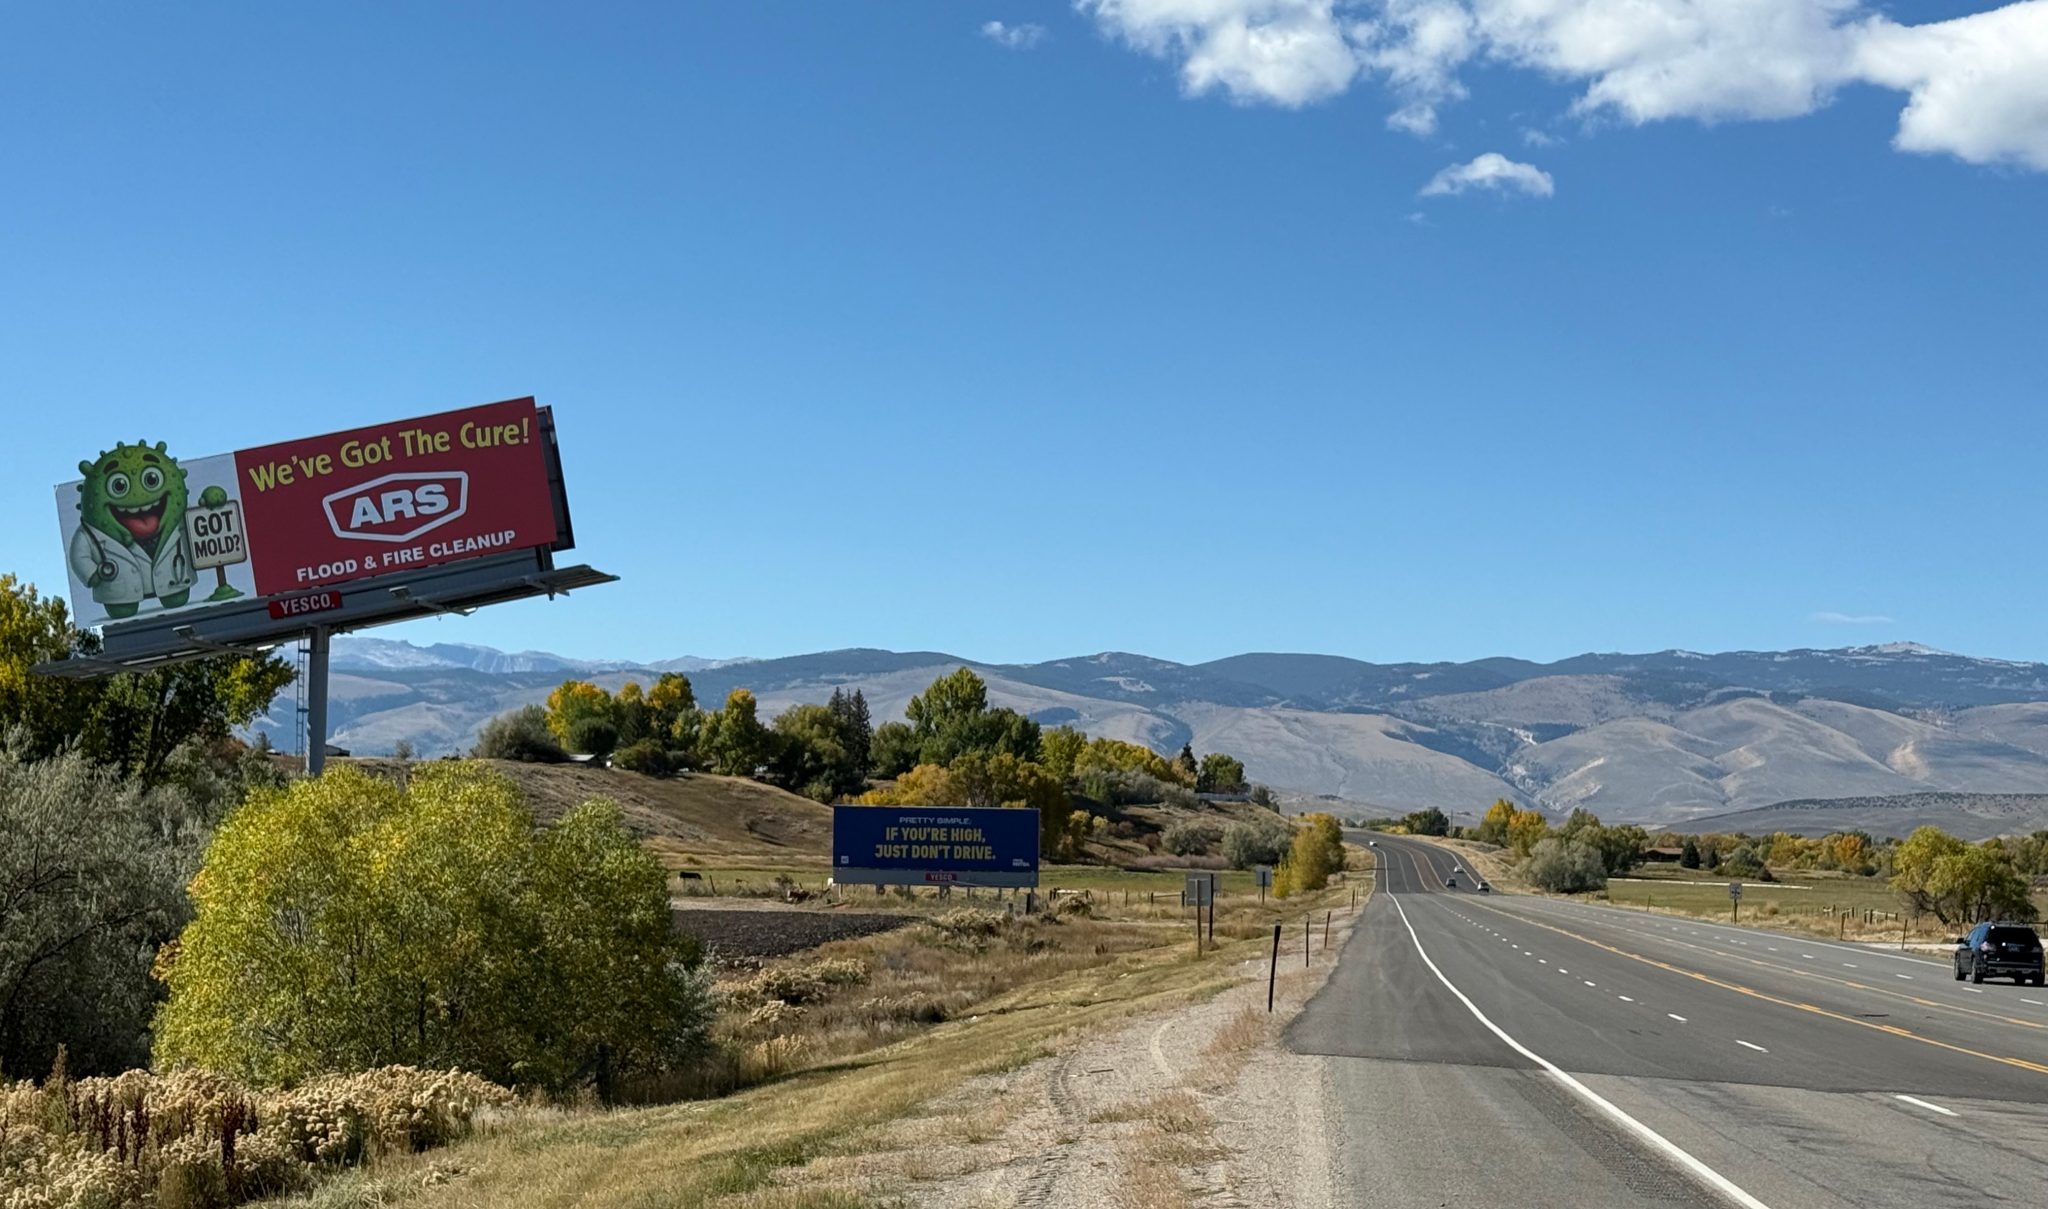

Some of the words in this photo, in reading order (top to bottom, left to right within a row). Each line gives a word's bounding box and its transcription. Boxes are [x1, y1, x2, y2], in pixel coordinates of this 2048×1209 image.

[248, 455, 333, 492] We've
[340, 436, 393, 468] Got
[398, 428, 451, 457] The
[460, 417, 529, 449] Cure!
[349, 483, 449, 529] ARS
[194, 510, 233, 537] GOT
[194, 534, 240, 559] MOLD?
[296, 559, 358, 583] FLOOD
[364, 555, 378, 570] &
[382, 546, 425, 567] FIRE
[429, 530, 516, 558] CLEANUP
[899, 816, 935, 825] PRETTY
[885, 827, 899, 841] IF
[901, 827, 948, 841] YOU'RE
[950, 828, 987, 843] HIGH,
[874, 844, 909, 858] JUST
[911, 845, 950, 859] DON'T
[953, 846, 997, 860] DRIVE.
